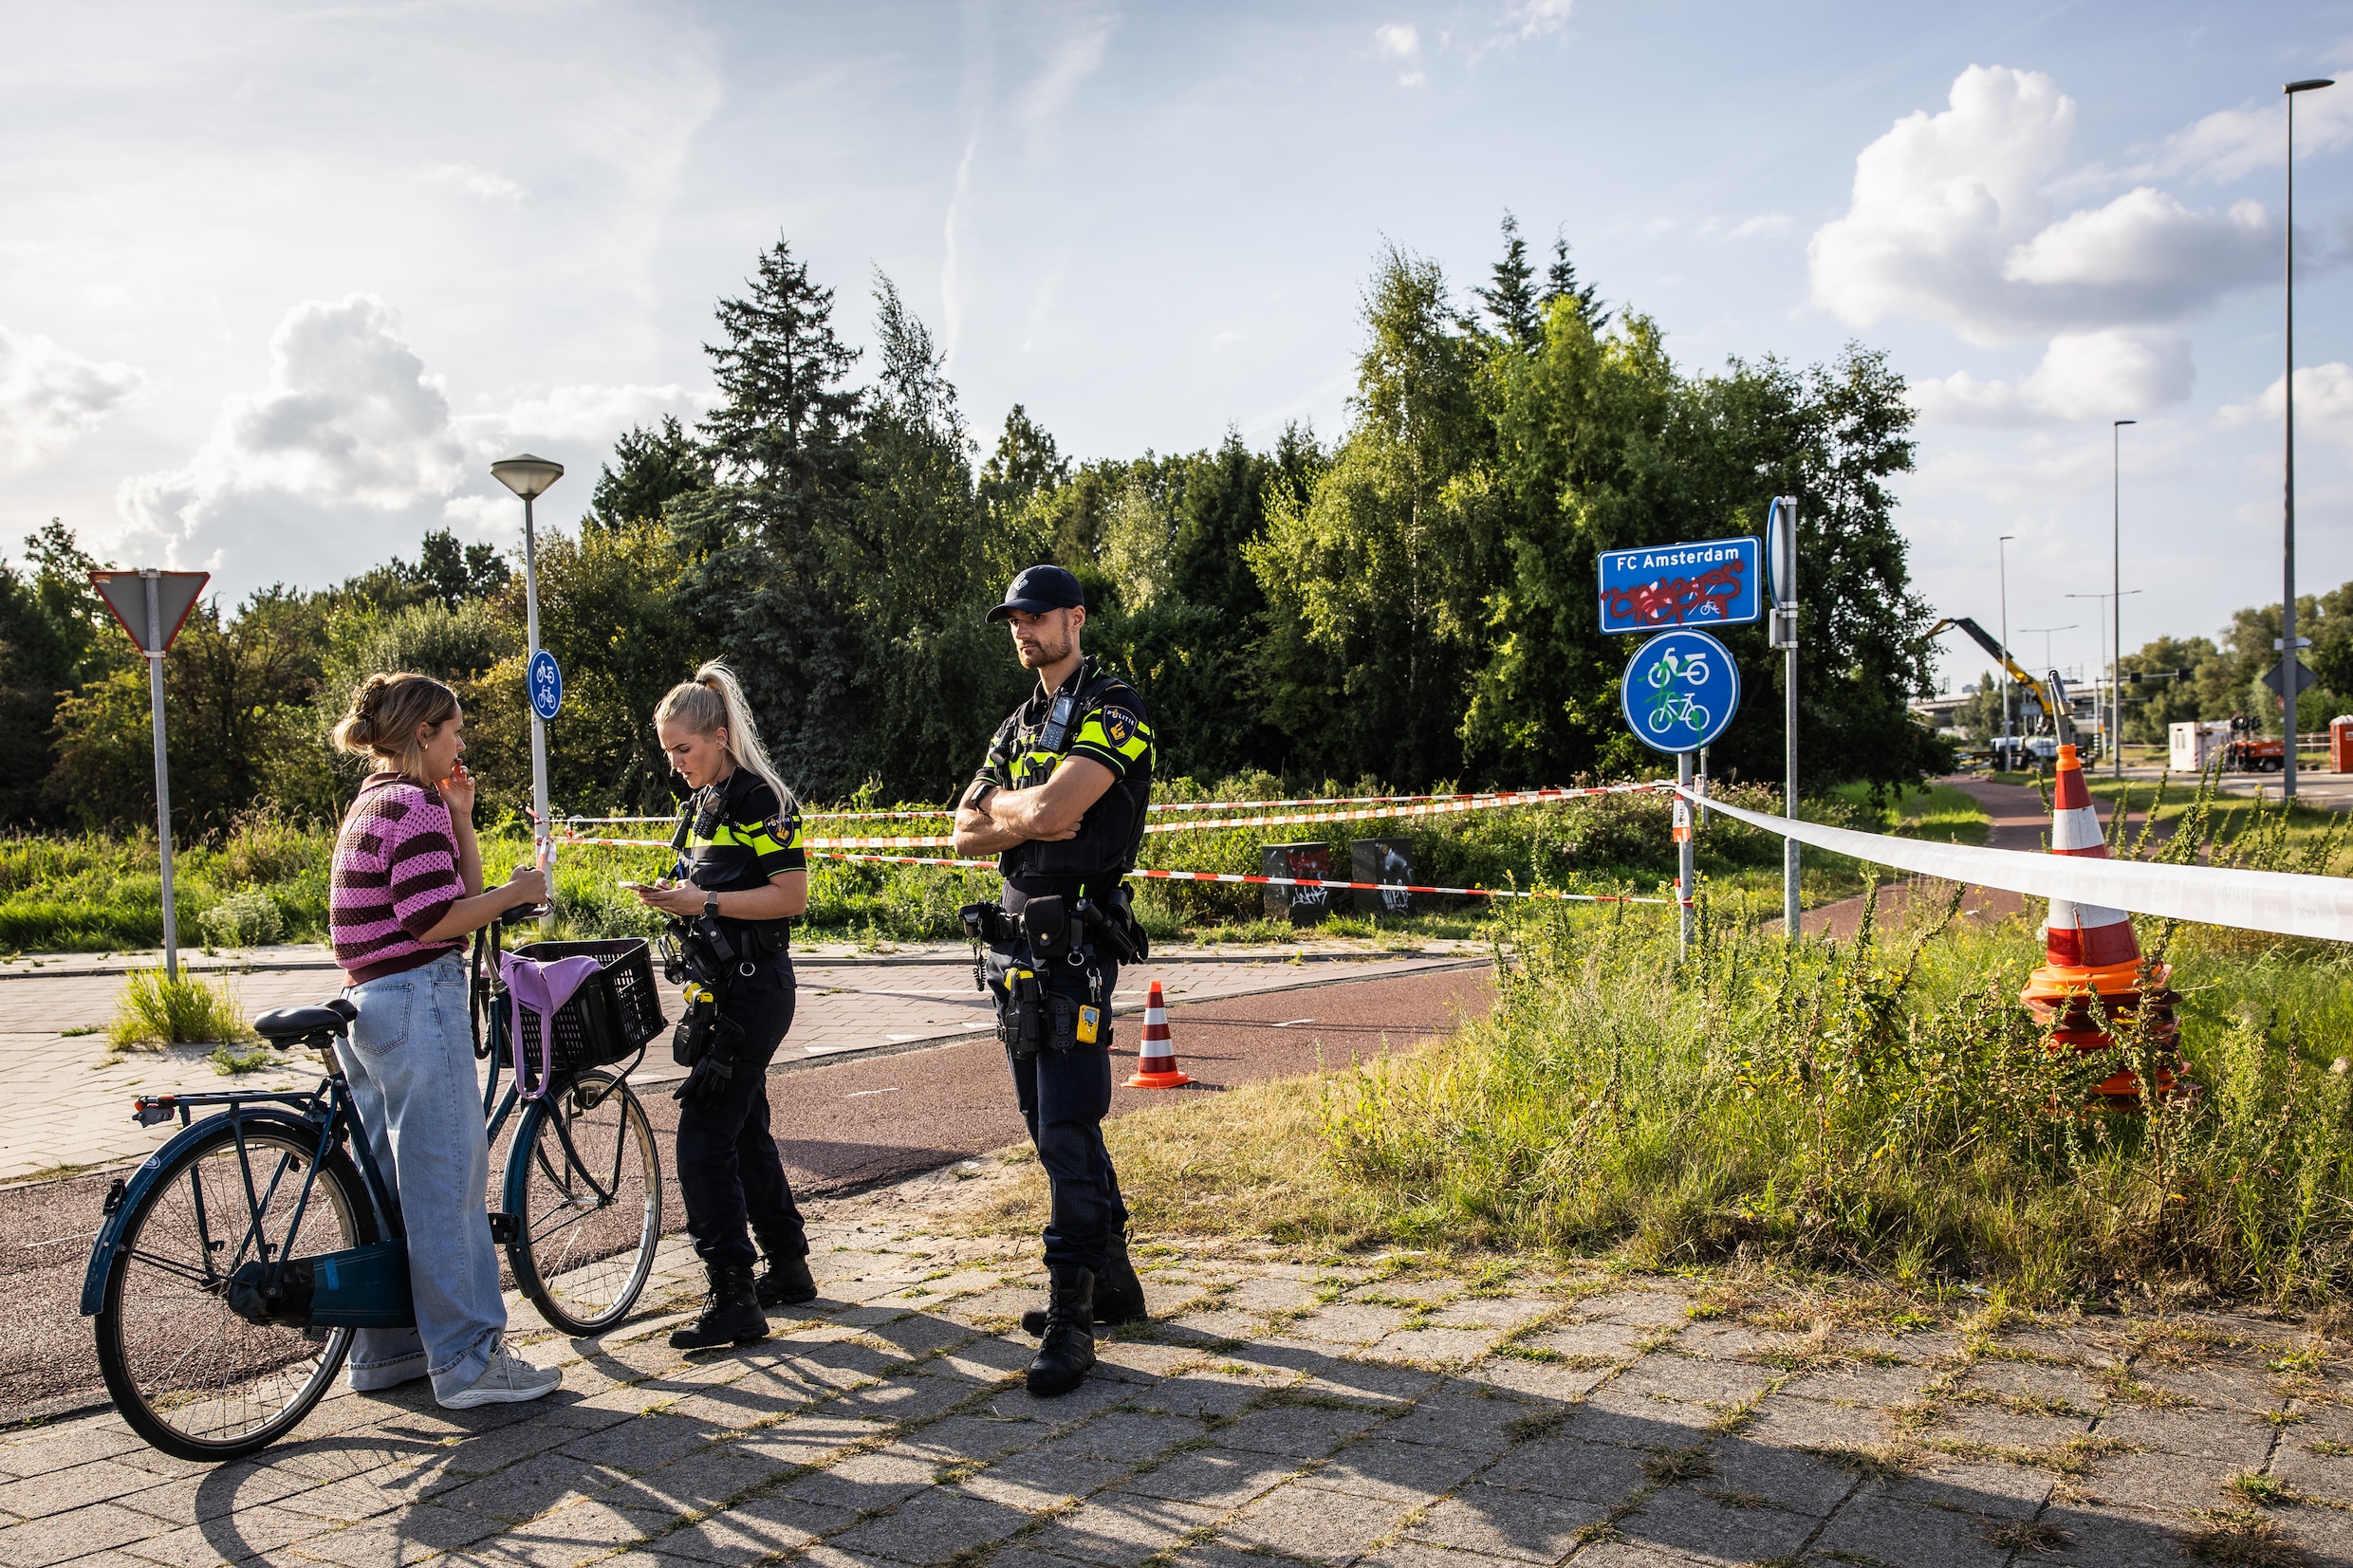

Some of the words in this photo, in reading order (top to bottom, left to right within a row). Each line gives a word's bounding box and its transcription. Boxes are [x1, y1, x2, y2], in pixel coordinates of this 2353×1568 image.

[1617, 556, 1637, 571] FC
[1643, 548, 1739, 568] Amsterdam
[1107, 710, 1135, 726] POLITIE
